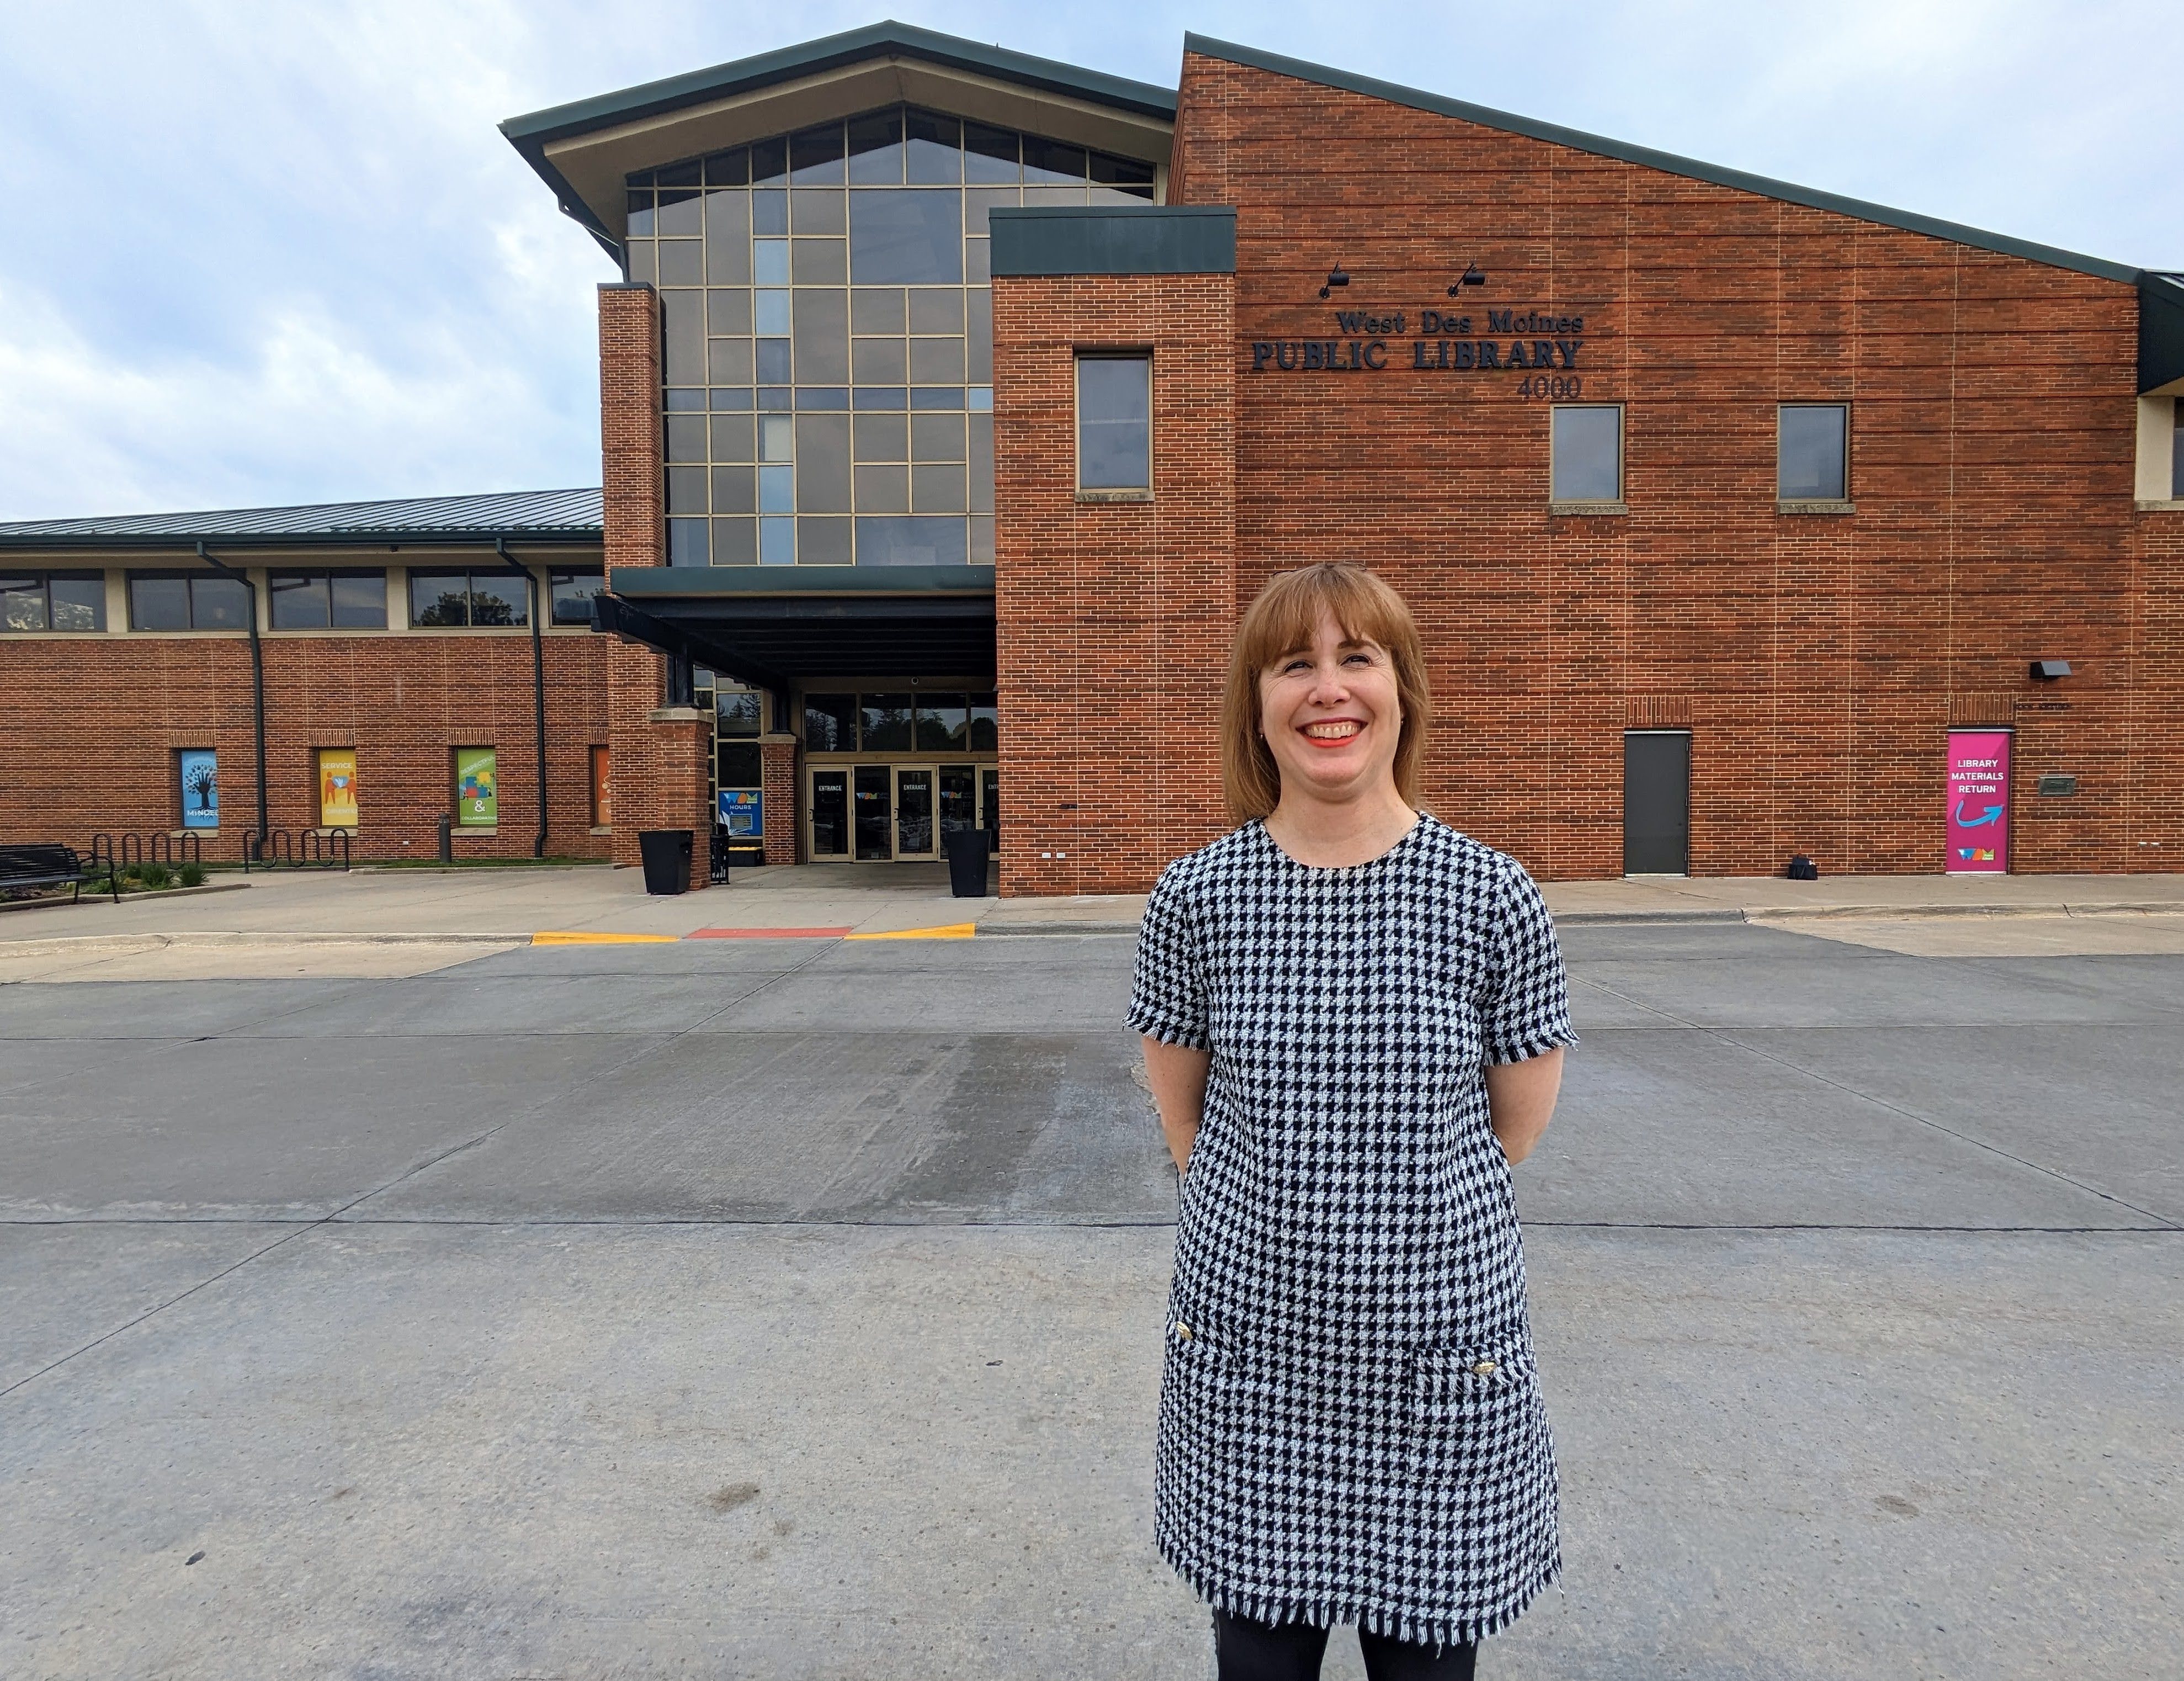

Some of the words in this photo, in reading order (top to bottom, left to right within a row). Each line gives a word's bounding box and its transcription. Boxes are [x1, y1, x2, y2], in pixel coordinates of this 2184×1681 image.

[1336, 311, 1405, 333] West
[1422, 310, 1471, 333] Des
[1489, 309, 1583, 333] Moines
[1252, 341, 1387, 370] PUBLIC
[1413, 340, 1583, 369] LIBRARY
[1516, 375, 1582, 399] 4000
[1951, 772, 2004, 781] MATERIALS
[1958, 785, 1996, 793] RETURN
[475, 800, 485, 812] &
